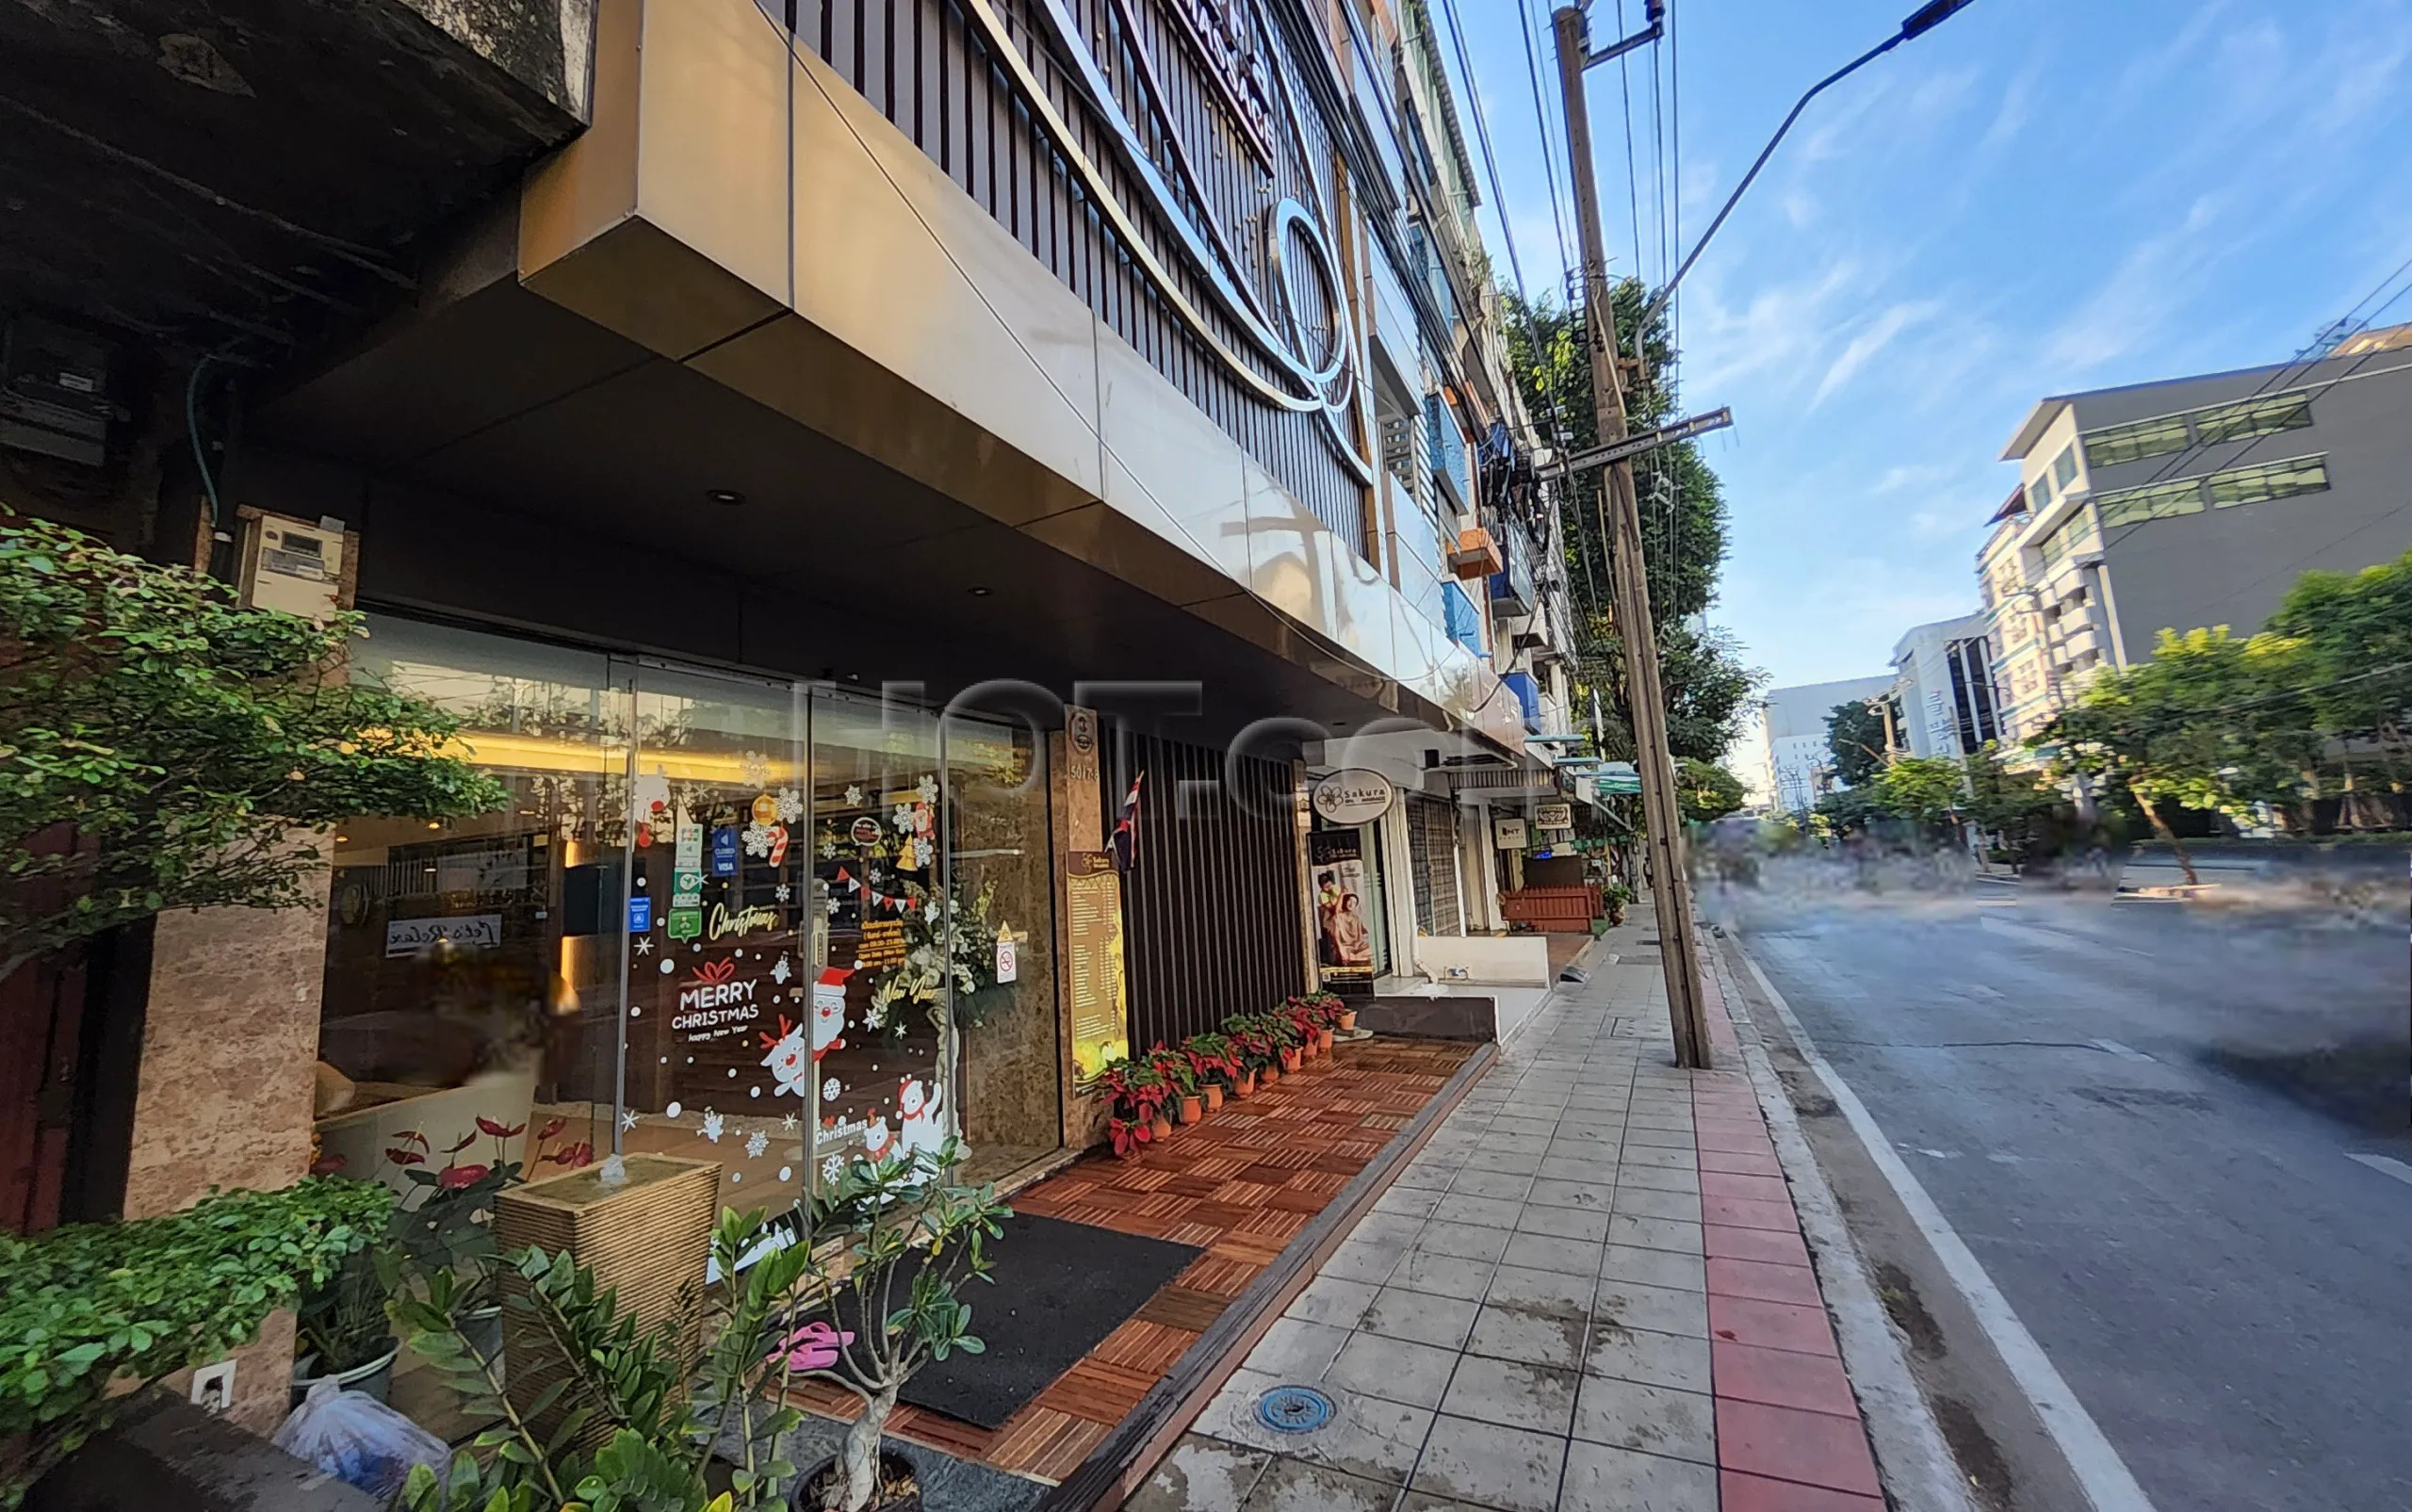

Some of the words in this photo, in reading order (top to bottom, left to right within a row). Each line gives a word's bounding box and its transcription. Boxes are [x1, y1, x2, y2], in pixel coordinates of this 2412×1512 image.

[1345, 788, 1385, 799] Sakura
[679, 978, 758, 1011] MERRY
[671, 1003, 759, 1030] CHRISTMAS
[816, 1118, 868, 1146] Christmas
